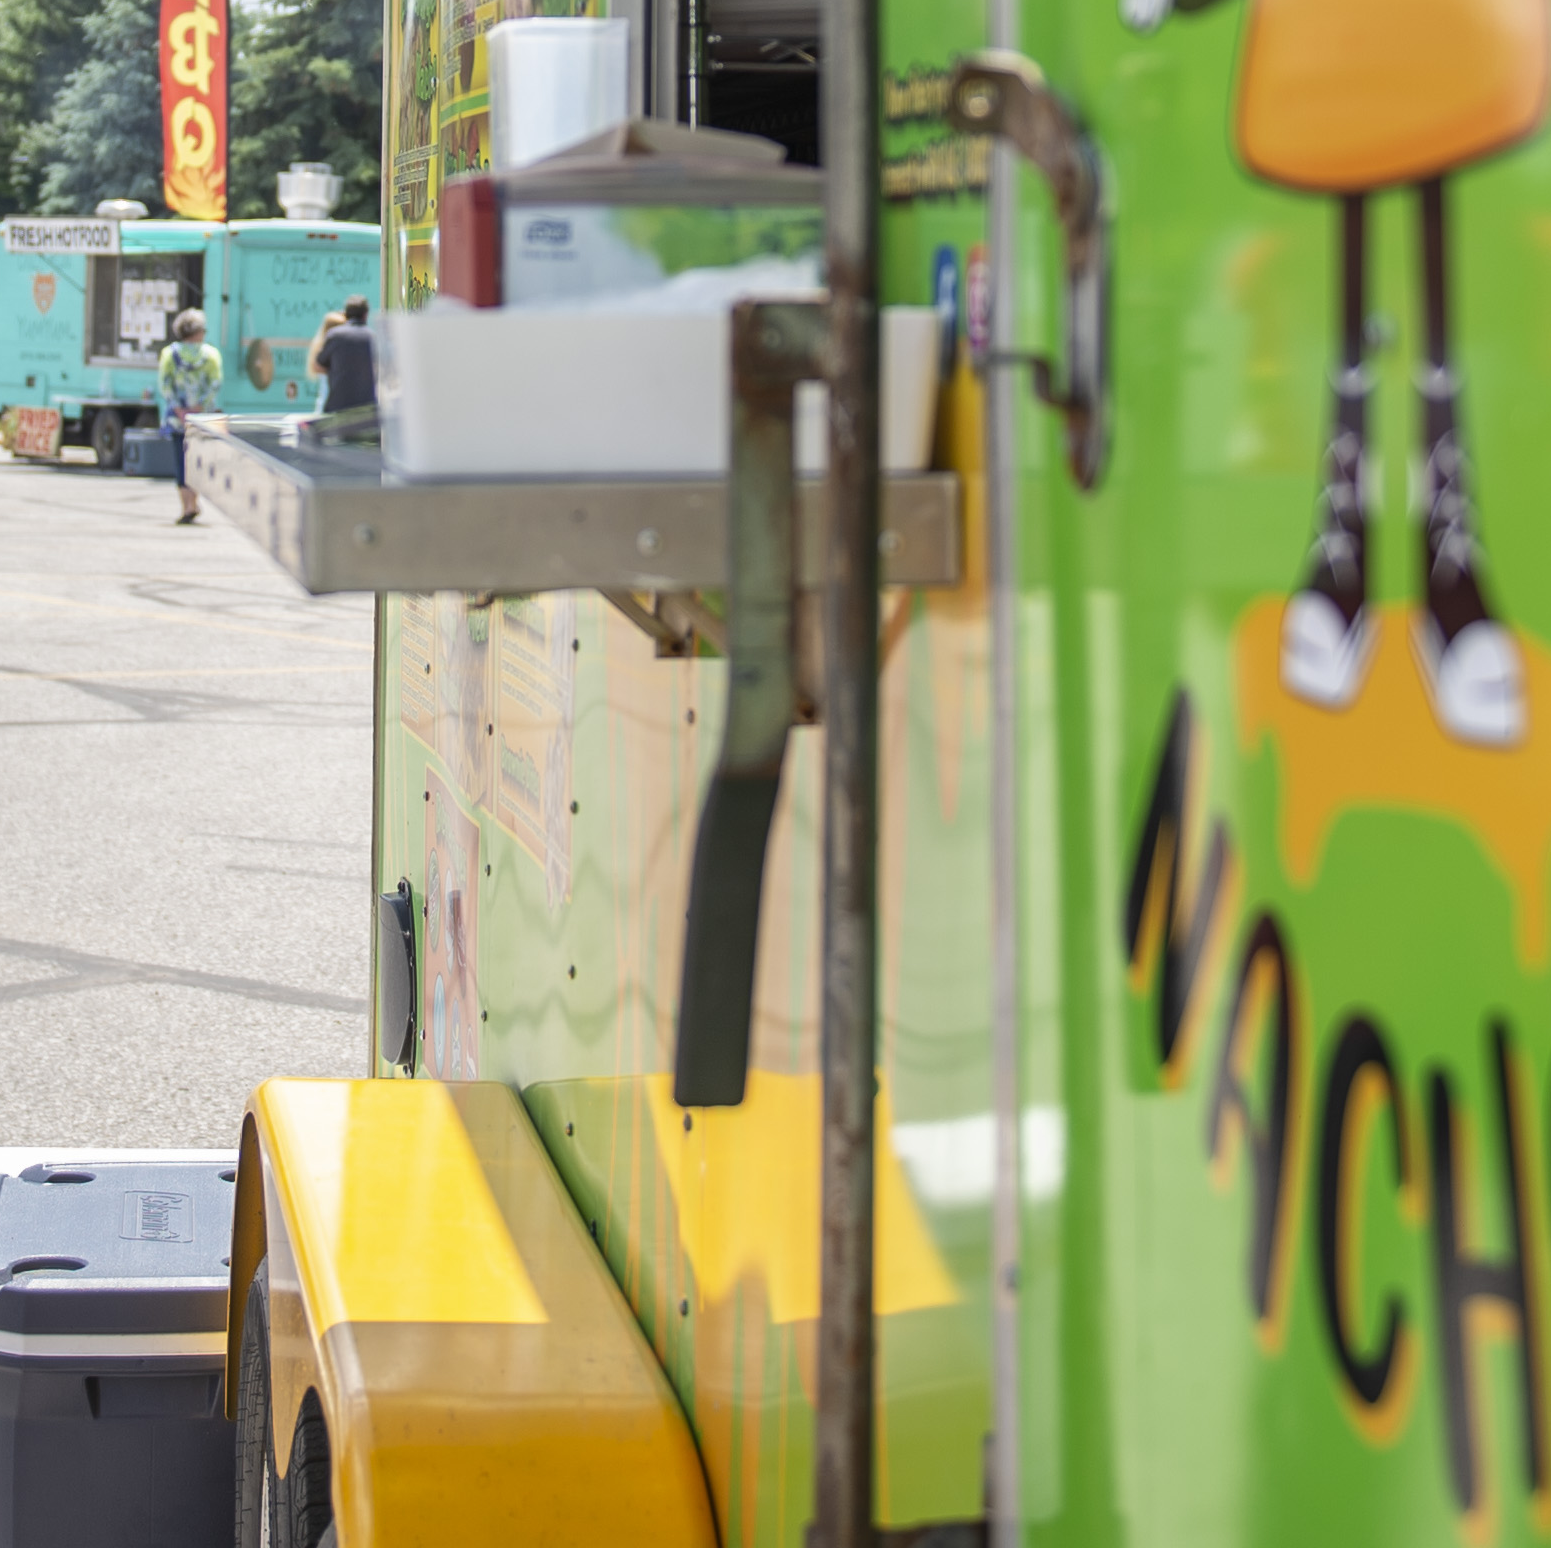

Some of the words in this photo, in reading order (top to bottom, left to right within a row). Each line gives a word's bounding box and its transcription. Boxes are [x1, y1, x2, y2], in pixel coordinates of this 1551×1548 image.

[9, 224, 52, 248] FRESH
[18, 407, 59, 431] FRIED
[18, 431, 51, 453] RICE
